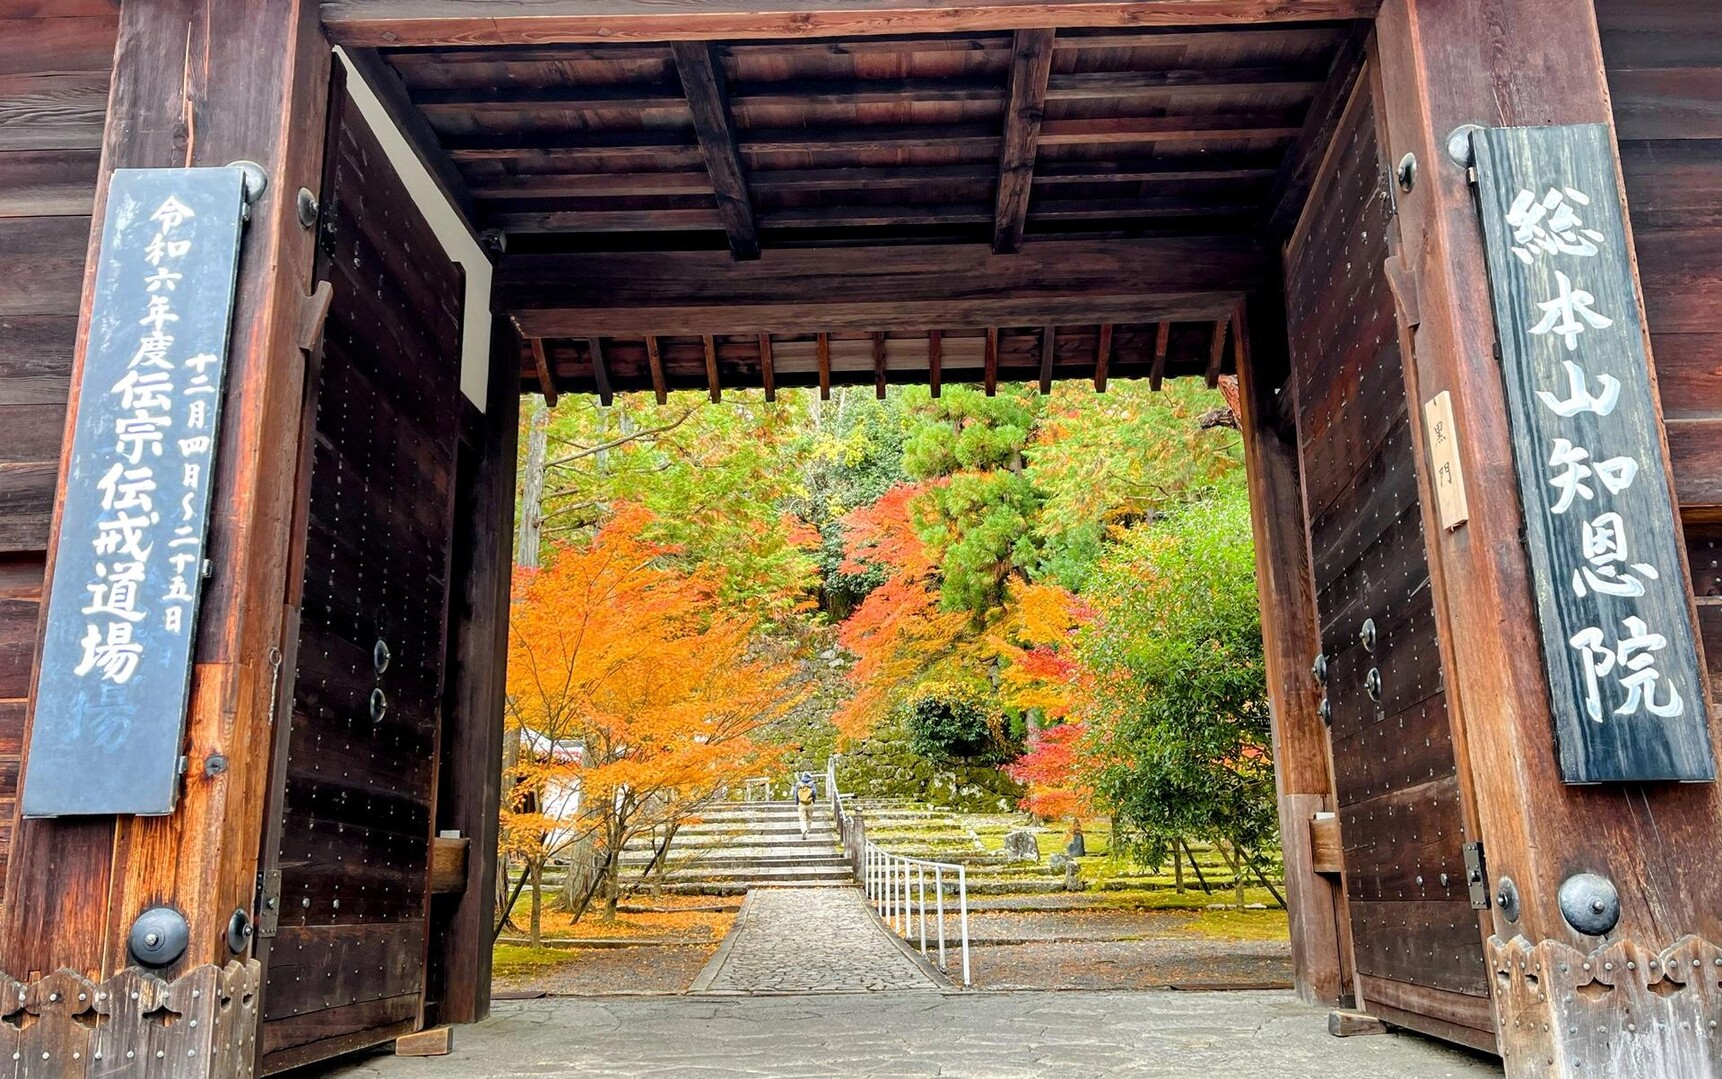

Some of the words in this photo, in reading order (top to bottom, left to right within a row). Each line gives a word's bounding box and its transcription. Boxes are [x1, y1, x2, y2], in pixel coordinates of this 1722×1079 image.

[74, 195, 195, 684] 令和六年度伝宗伝戒道場
[1505, 187, 1685, 722] 総本山知恩院
